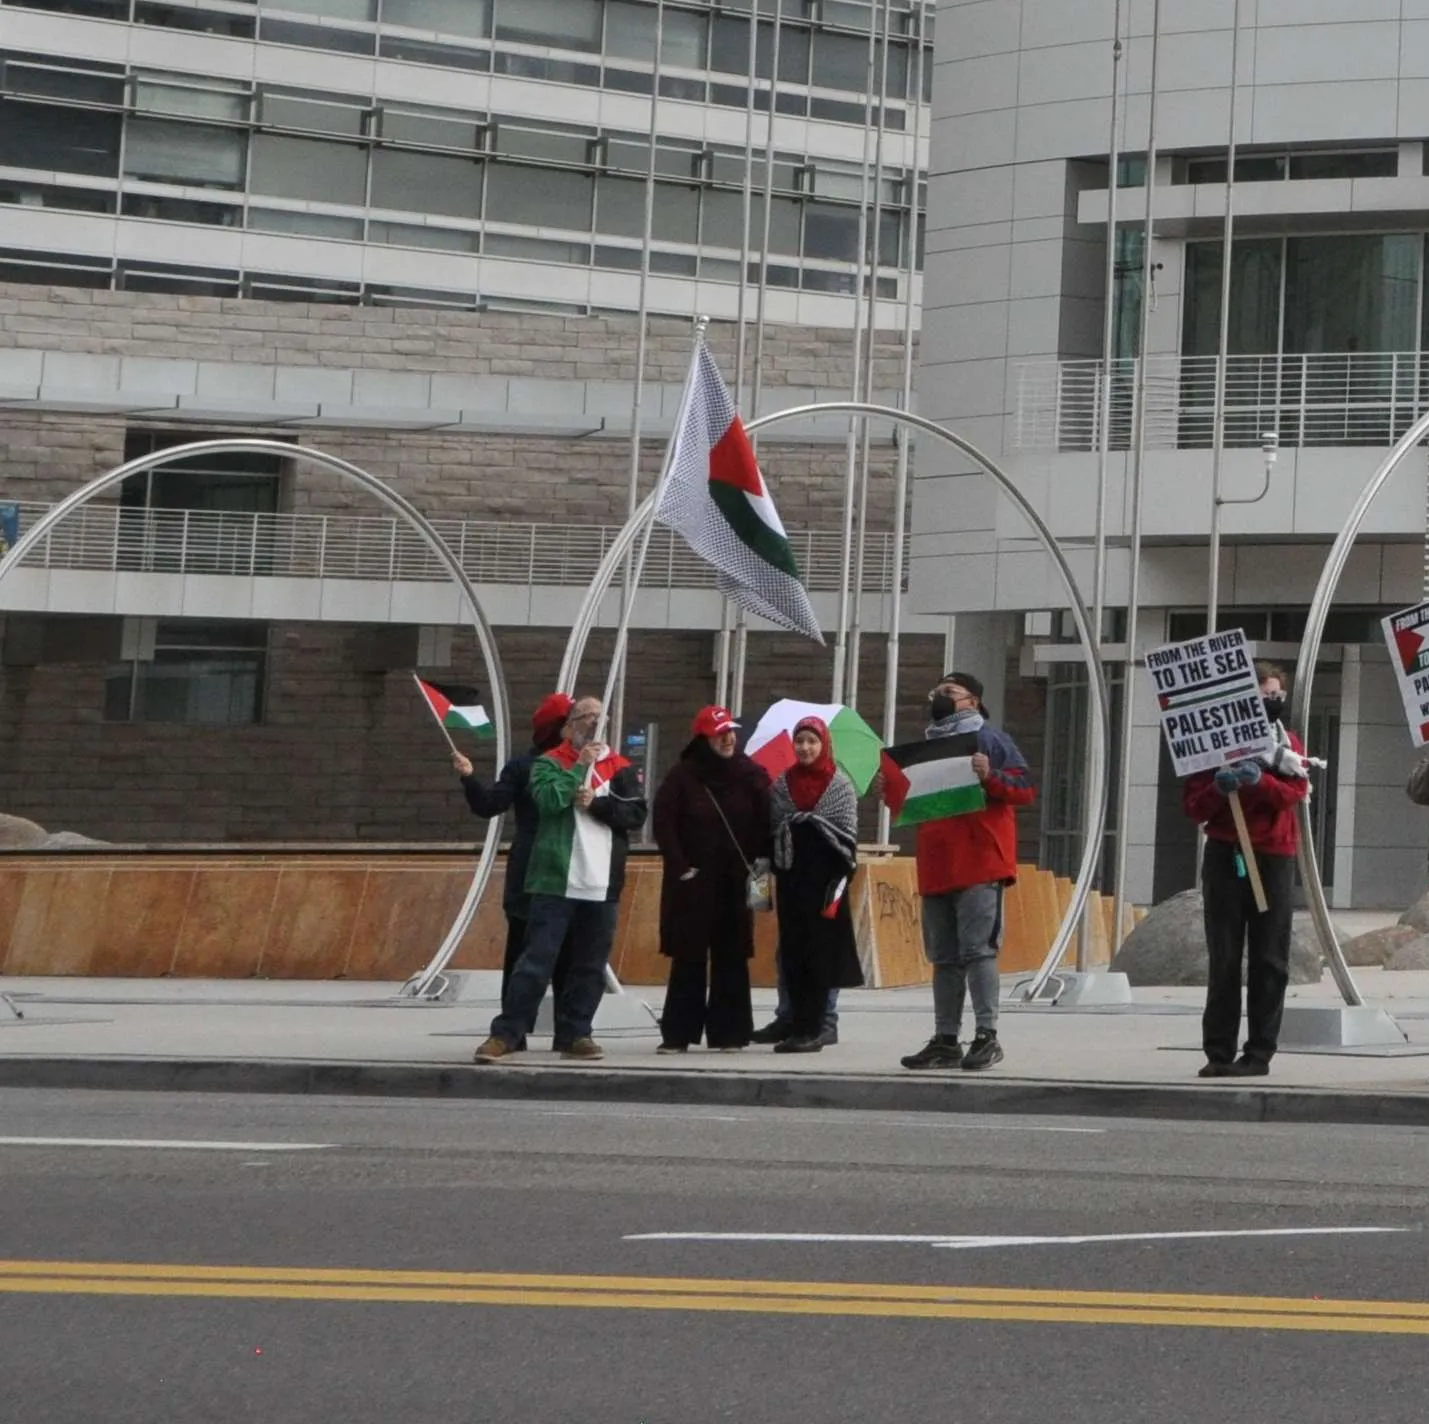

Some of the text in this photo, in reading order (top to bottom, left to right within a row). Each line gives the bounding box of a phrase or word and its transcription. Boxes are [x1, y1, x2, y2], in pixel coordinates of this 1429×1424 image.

[1396, 613, 1420, 631] FROM
[1147, 631, 1244, 669] FROM THE RIVER
[1152, 649, 1249, 690] TO THE SEA
[1166, 696, 1263, 739] PALESTINE
[1172, 737, 1208, 759] WILL
[1210, 729, 1230, 750] BE
[1232, 720, 1269, 744] FREE
